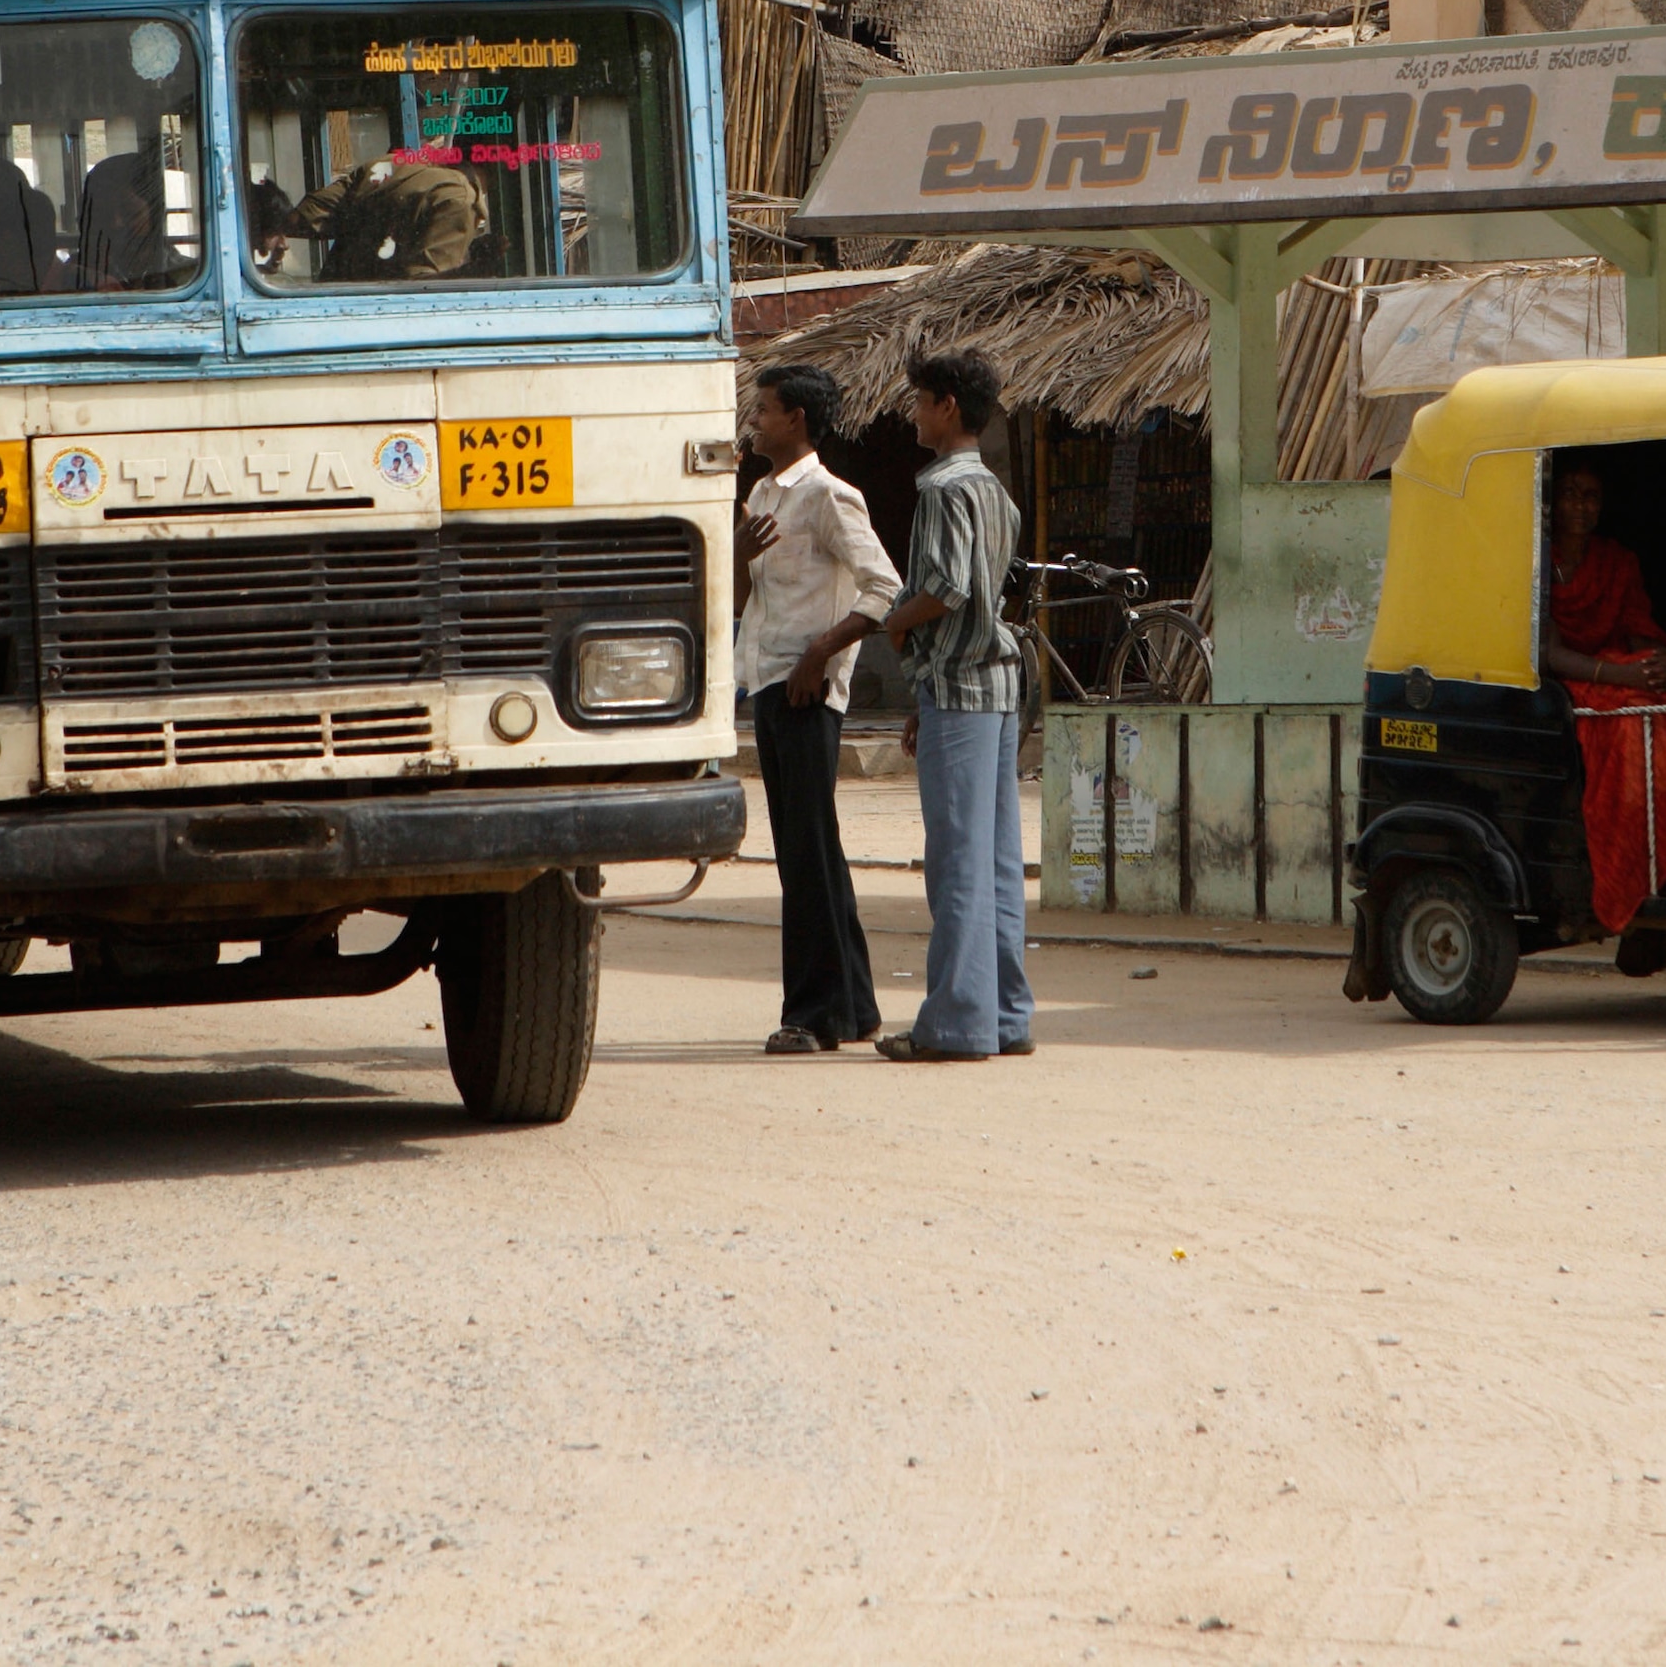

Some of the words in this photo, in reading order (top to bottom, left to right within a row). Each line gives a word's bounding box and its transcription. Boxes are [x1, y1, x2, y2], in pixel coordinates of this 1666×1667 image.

[424, 86, 509, 107] 1-1-2007
[919, 98, 1190, 196] ಬಸ್
[119, 451, 355, 499] TATA
